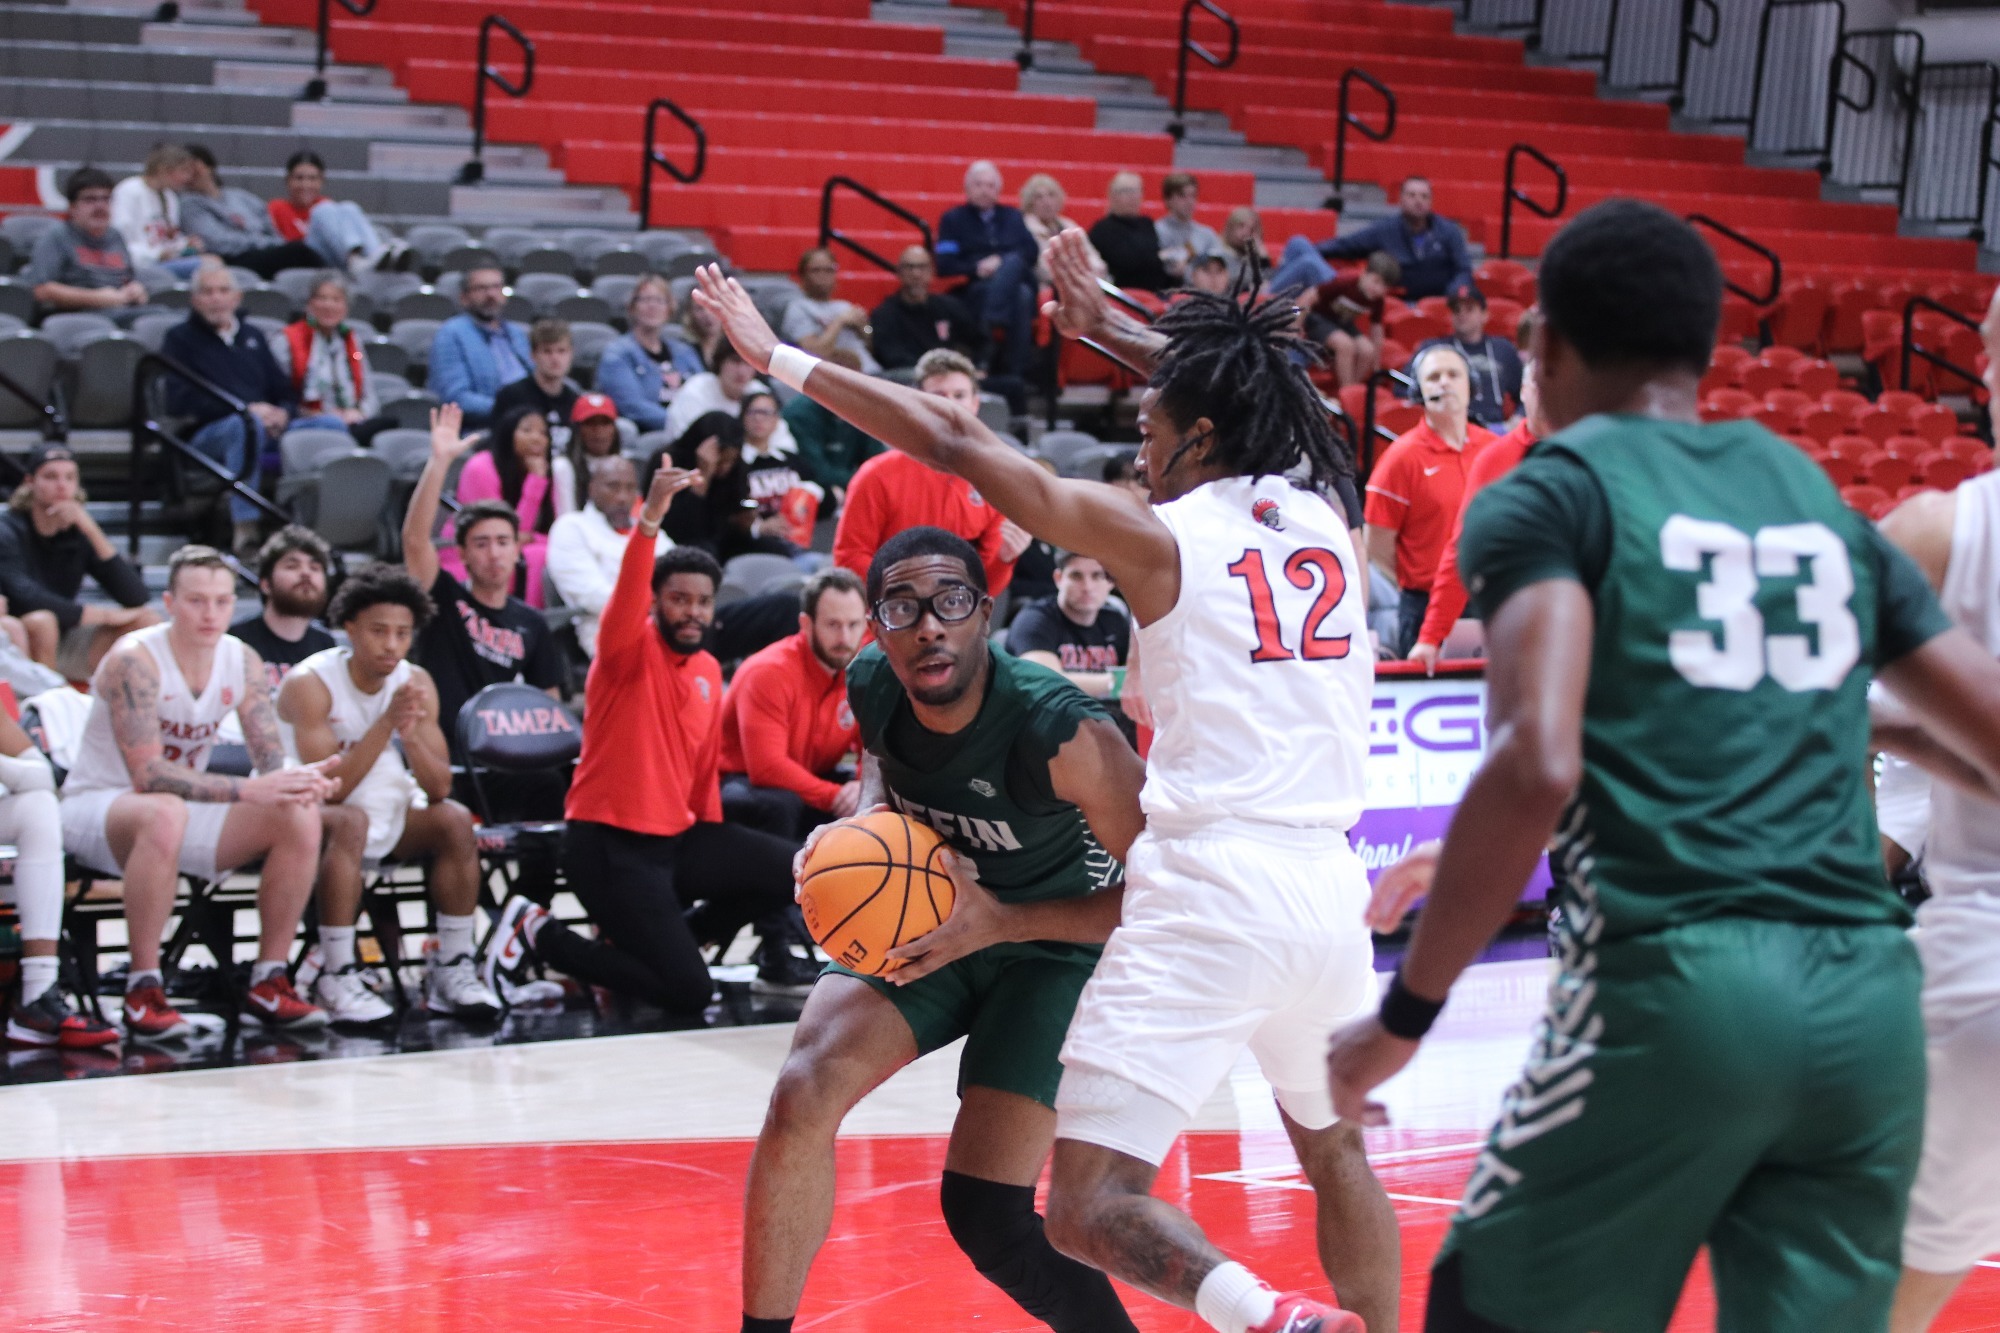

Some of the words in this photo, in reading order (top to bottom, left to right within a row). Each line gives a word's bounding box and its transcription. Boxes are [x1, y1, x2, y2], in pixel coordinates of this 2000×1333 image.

[1227, 547, 1352, 664] 12
[1659, 513, 1861, 692] 33
[477, 706, 573, 736] TAMPA
